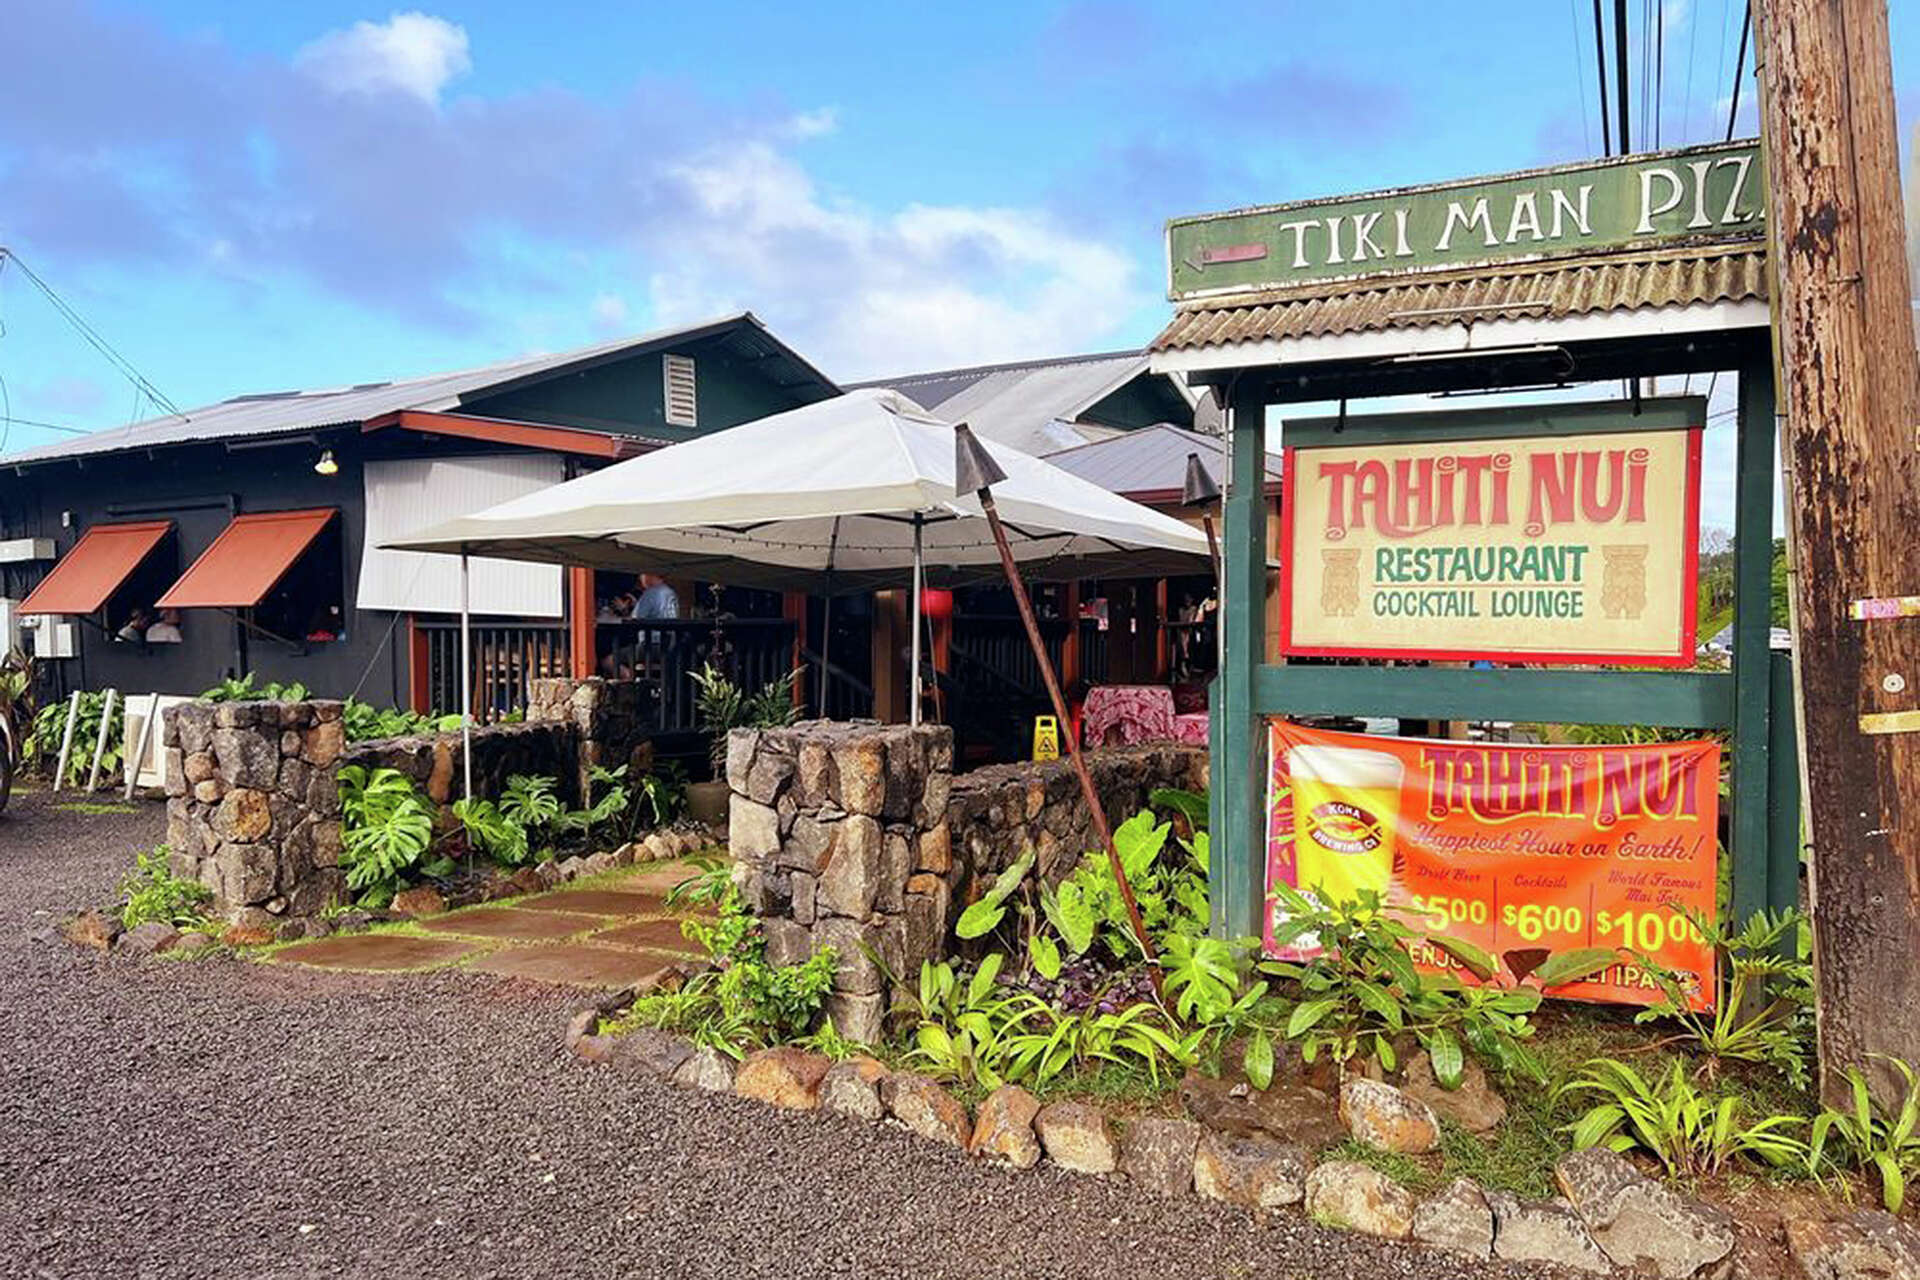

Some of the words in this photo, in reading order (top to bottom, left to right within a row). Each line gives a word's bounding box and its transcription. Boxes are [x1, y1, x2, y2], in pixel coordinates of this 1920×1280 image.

[1279, 207, 1415, 269] TIKI
[1434, 184, 1595, 252] MAN
[1633, 154, 1765, 235] PIZ
[1374, 545, 1589, 583] RESTAURANT
[1372, 590, 1481, 618] COCKTAIL
[1490, 589, 1584, 619] LOUNGE
[1328, 803, 1361, 819] KONA
[1408, 822, 1511, 857] Happiest
[1511, 828, 1576, 857] Hour
[1580, 842, 1609, 859] on
[1616, 830, 1705, 862] Earth!
[1513, 873, 1568, 889] Cocktails
[1607, 868, 1649, 886] World
[1650, 871, 1703, 889] Famous
[1625, 886, 1650, 903] Mai
[1615, 965, 1656, 990] IPA
